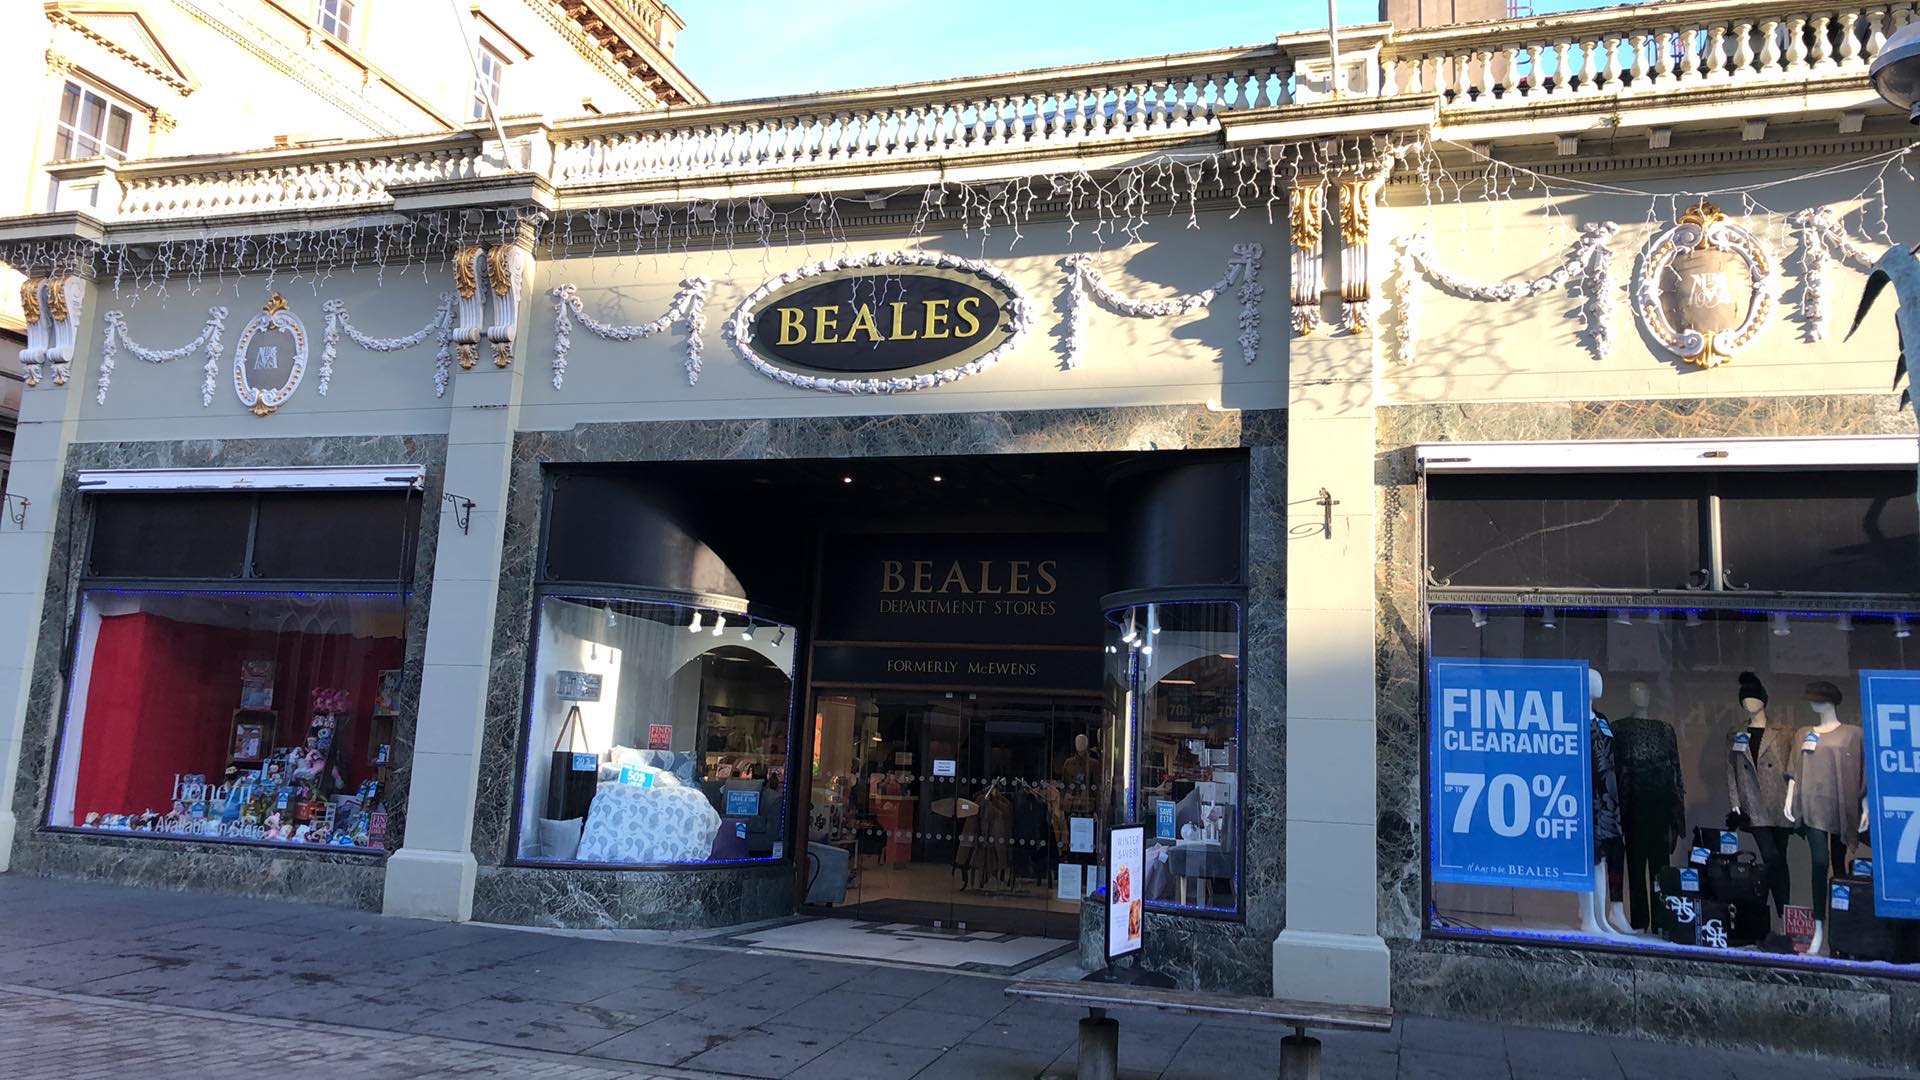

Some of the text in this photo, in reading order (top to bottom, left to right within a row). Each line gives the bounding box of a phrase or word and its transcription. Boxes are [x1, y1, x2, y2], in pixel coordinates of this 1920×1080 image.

[775, 297, 980, 346] BEALES
[880, 560, 1057, 595] BEALES
[879, 599, 1056, 616] DEPARTMENT STORES
[887, 659, 959, 674] FORMERLY
[1443, 688, 1578, 732] FINAL
[1443, 730, 1579, 756] CLEARANCE
[170, 773, 255, 807] benefit
[1444, 785, 1464, 794] UP TO
[1159, 808, 1172, 816] SAVE
[1444, 772, 1578, 838] 70%
[1535, 818, 1578, 840] OFF
[1508, 864, 1560, 878] BEALES
